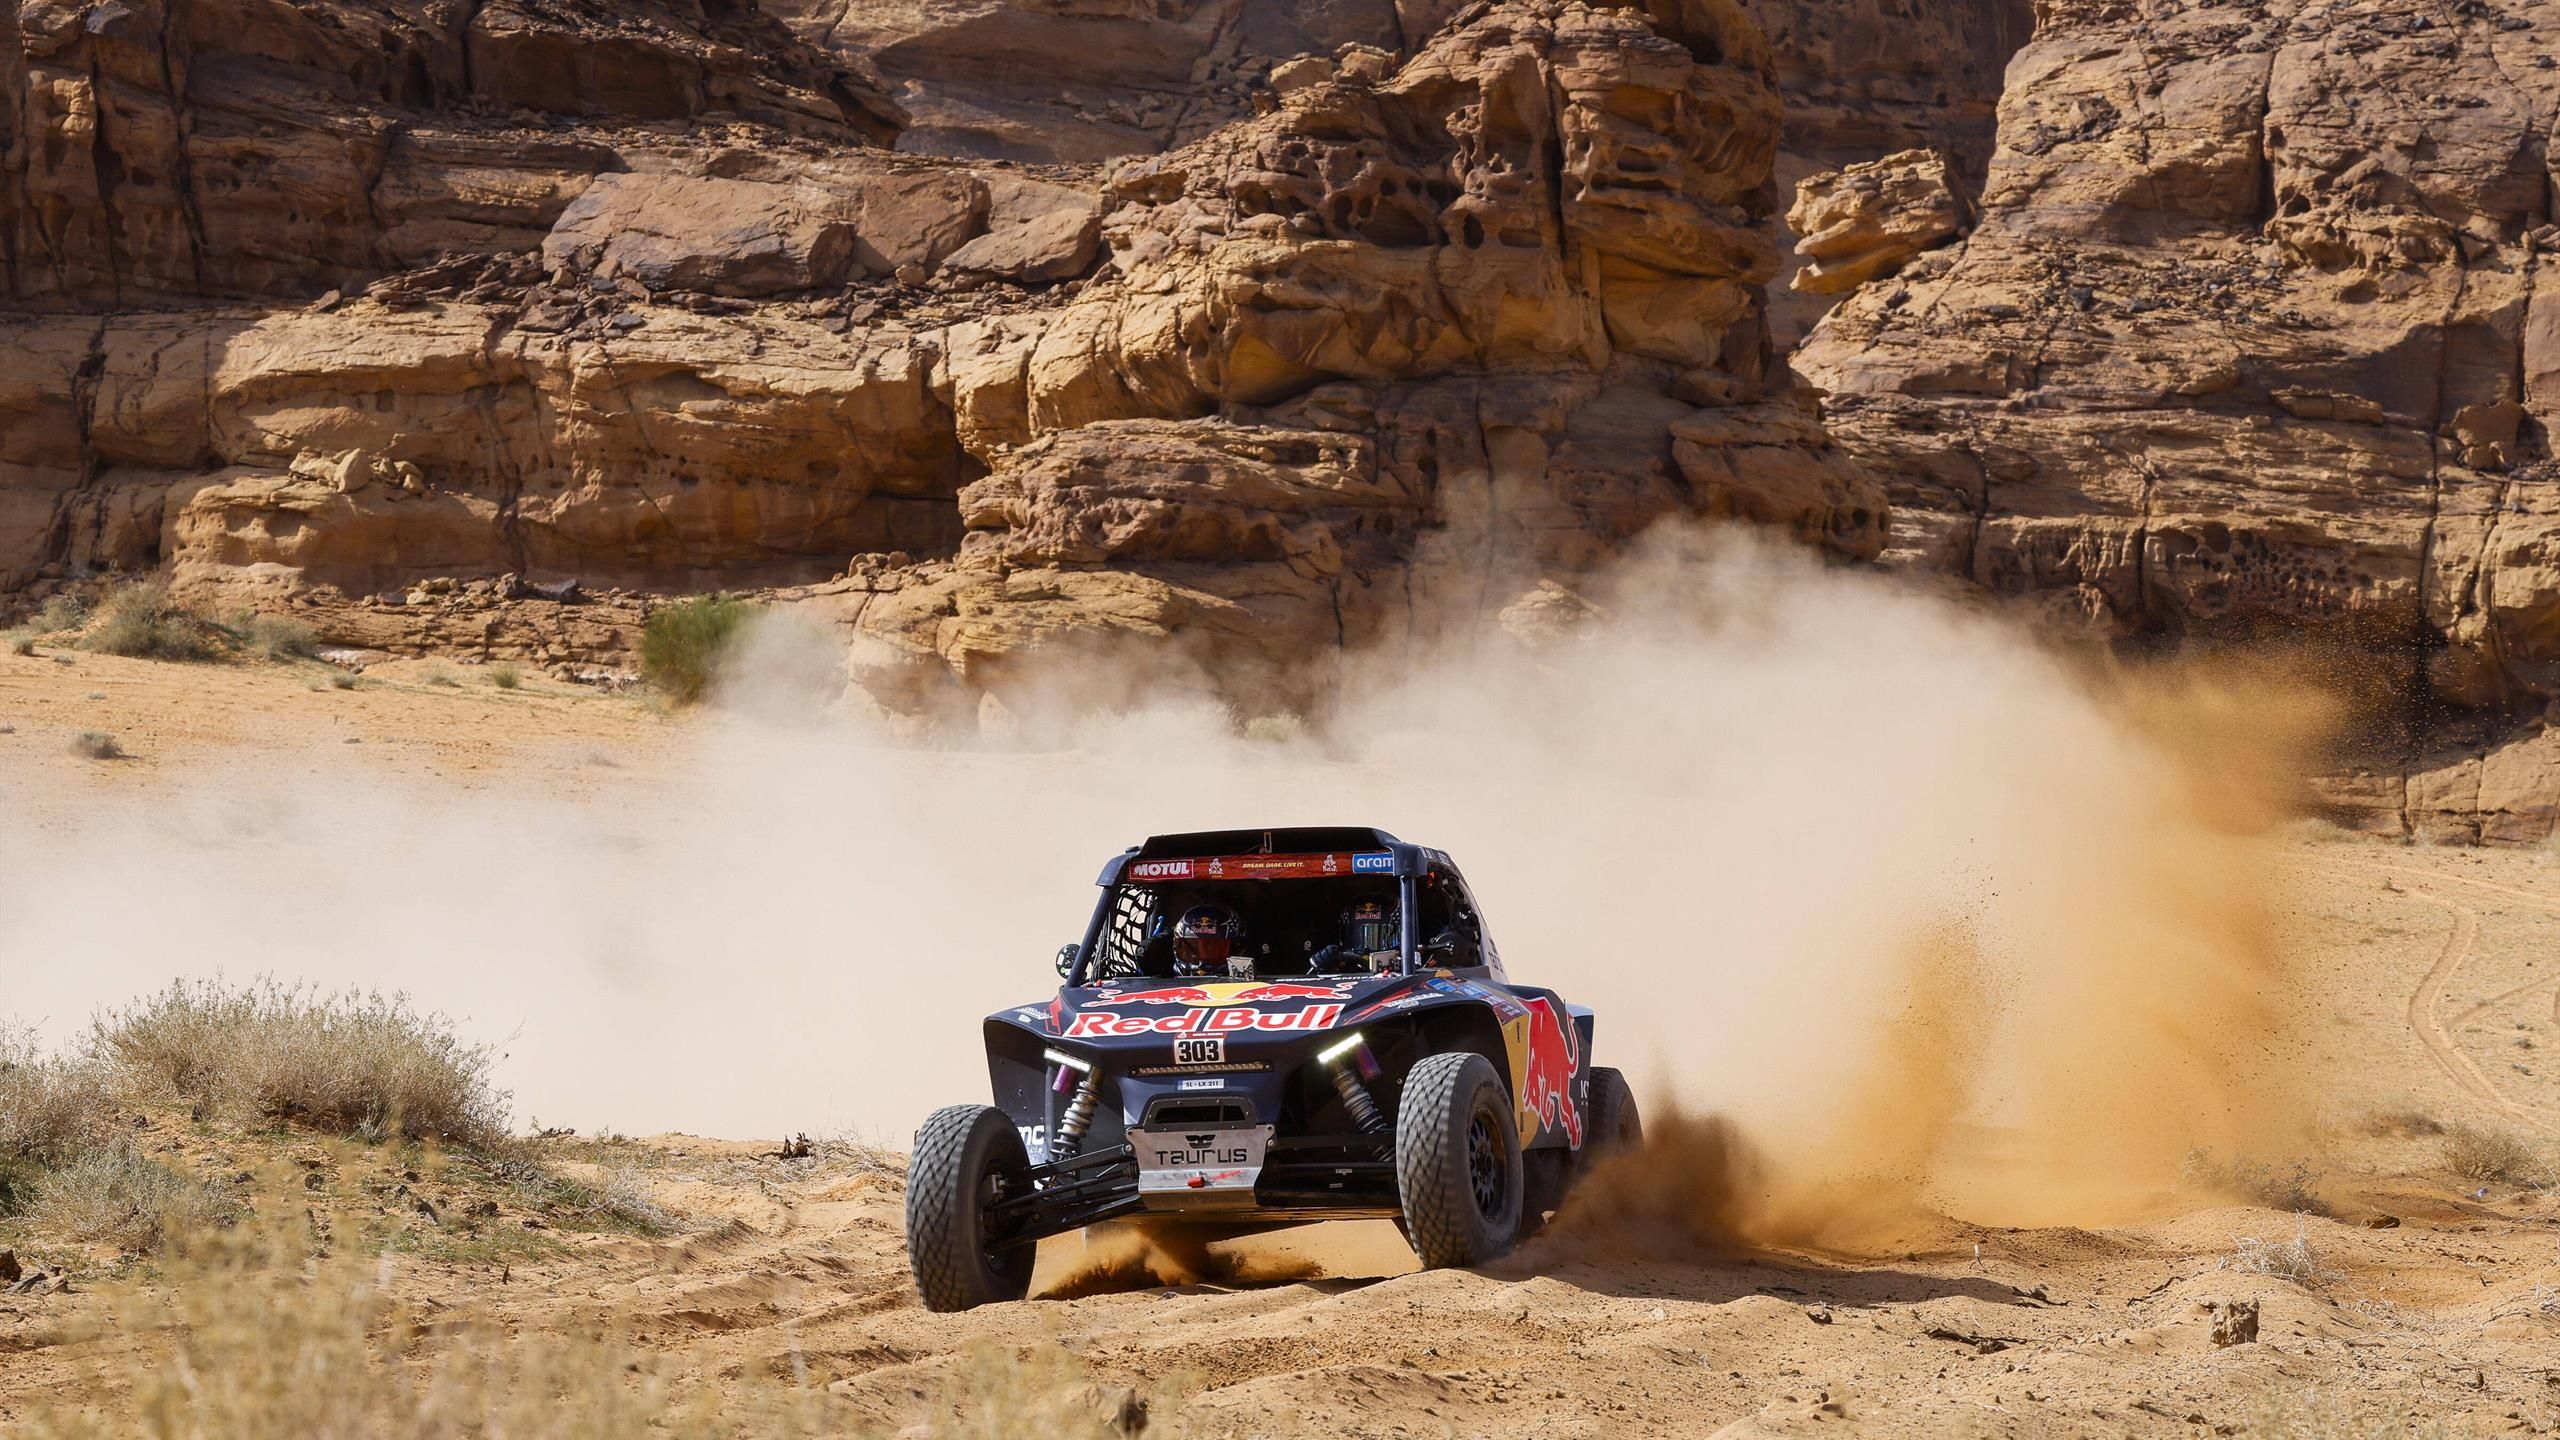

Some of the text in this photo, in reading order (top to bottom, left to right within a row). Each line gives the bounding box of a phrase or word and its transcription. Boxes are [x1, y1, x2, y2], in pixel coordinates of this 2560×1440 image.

[1134, 862, 1190, 876] MOTUL
[1356, 857, 1394, 868] aram
[1065, 1006, 1203, 1037] Red
[1206, 1003, 1344, 1031] Bull
[1178, 1040, 1220, 1062] 303
